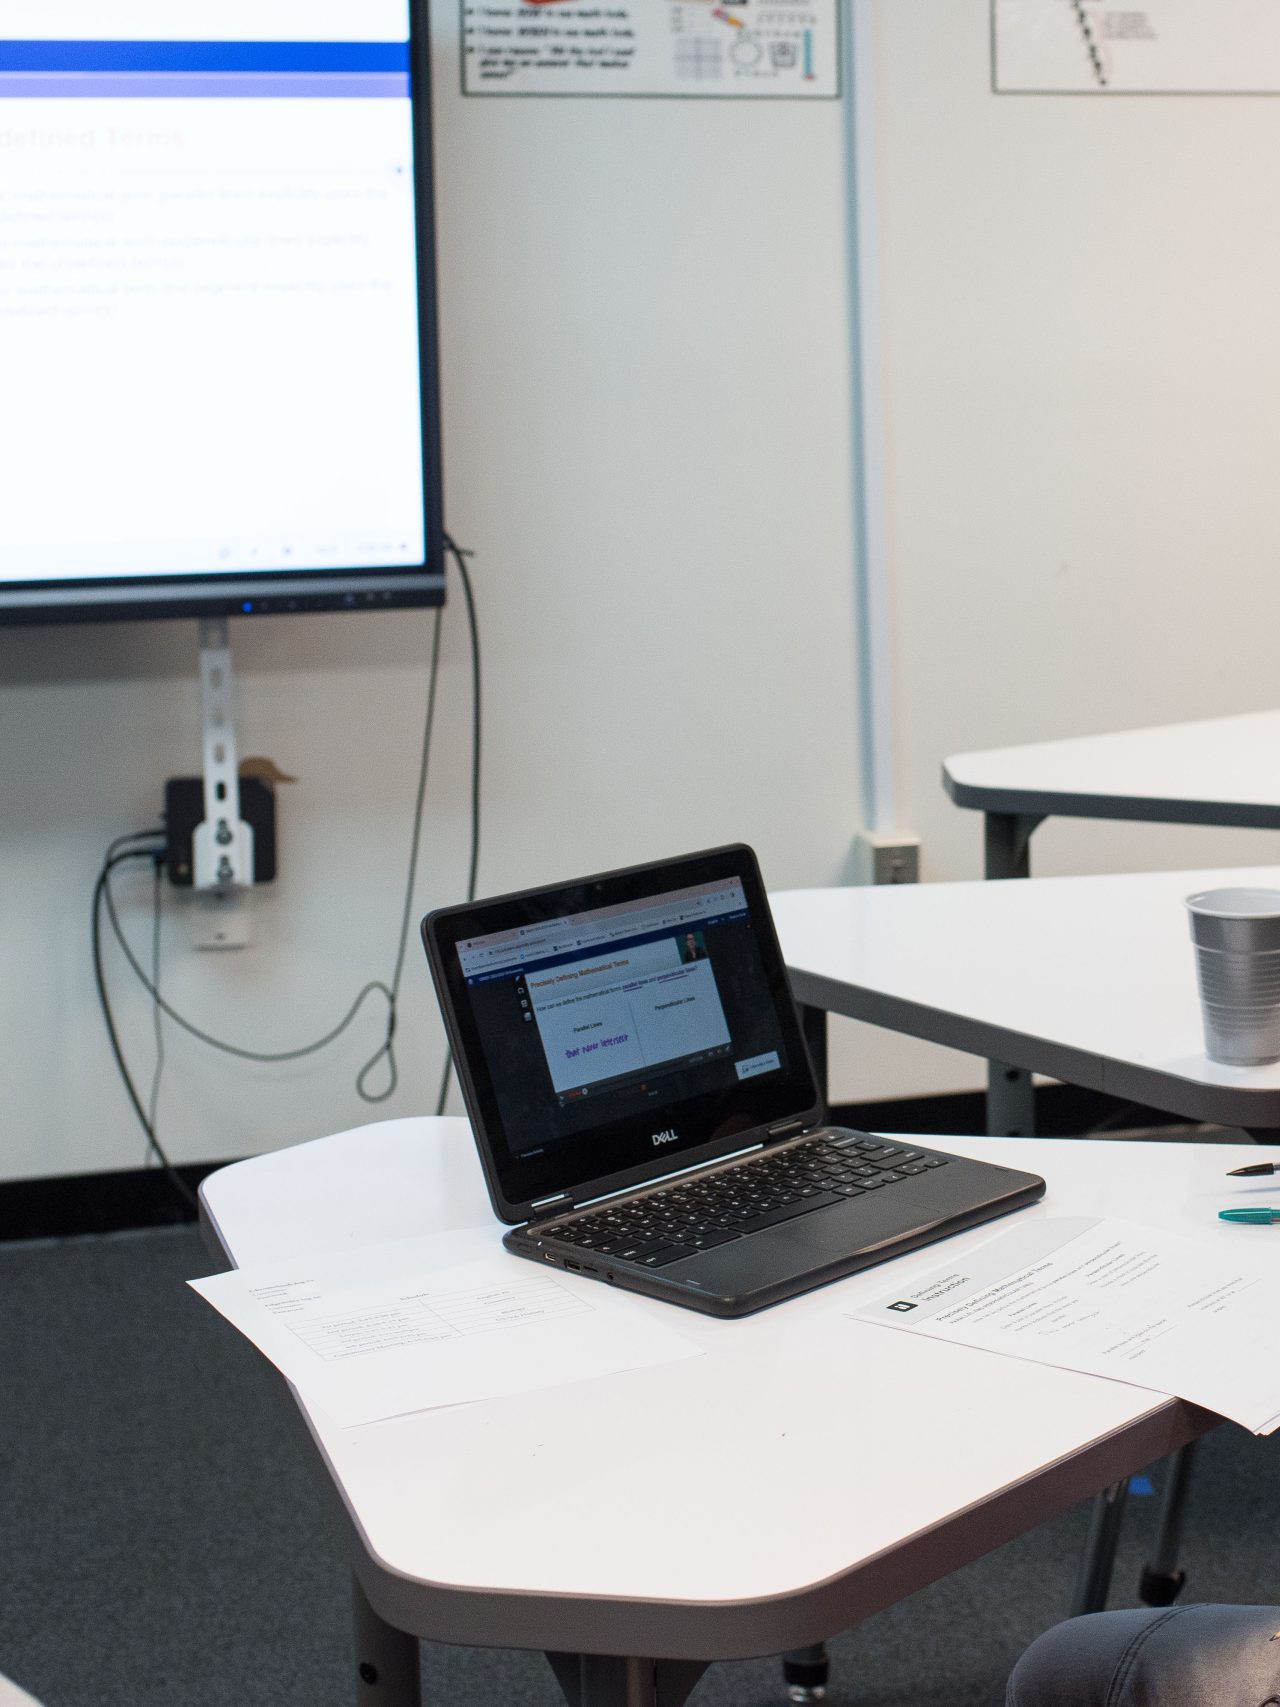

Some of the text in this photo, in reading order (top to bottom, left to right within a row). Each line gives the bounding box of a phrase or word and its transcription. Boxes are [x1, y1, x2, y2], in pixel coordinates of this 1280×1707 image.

[105, 127, 186, 147] Terms
[530, 958, 629, 989] Precisely Defining Mathematical Terms
[654, 999, 683, 1010] Perpendicular
[573, 1024, 590, 1032] Parallel
[652, 1128, 679, 1146] DELL
[922, 1276, 970, 1302] Instruction
